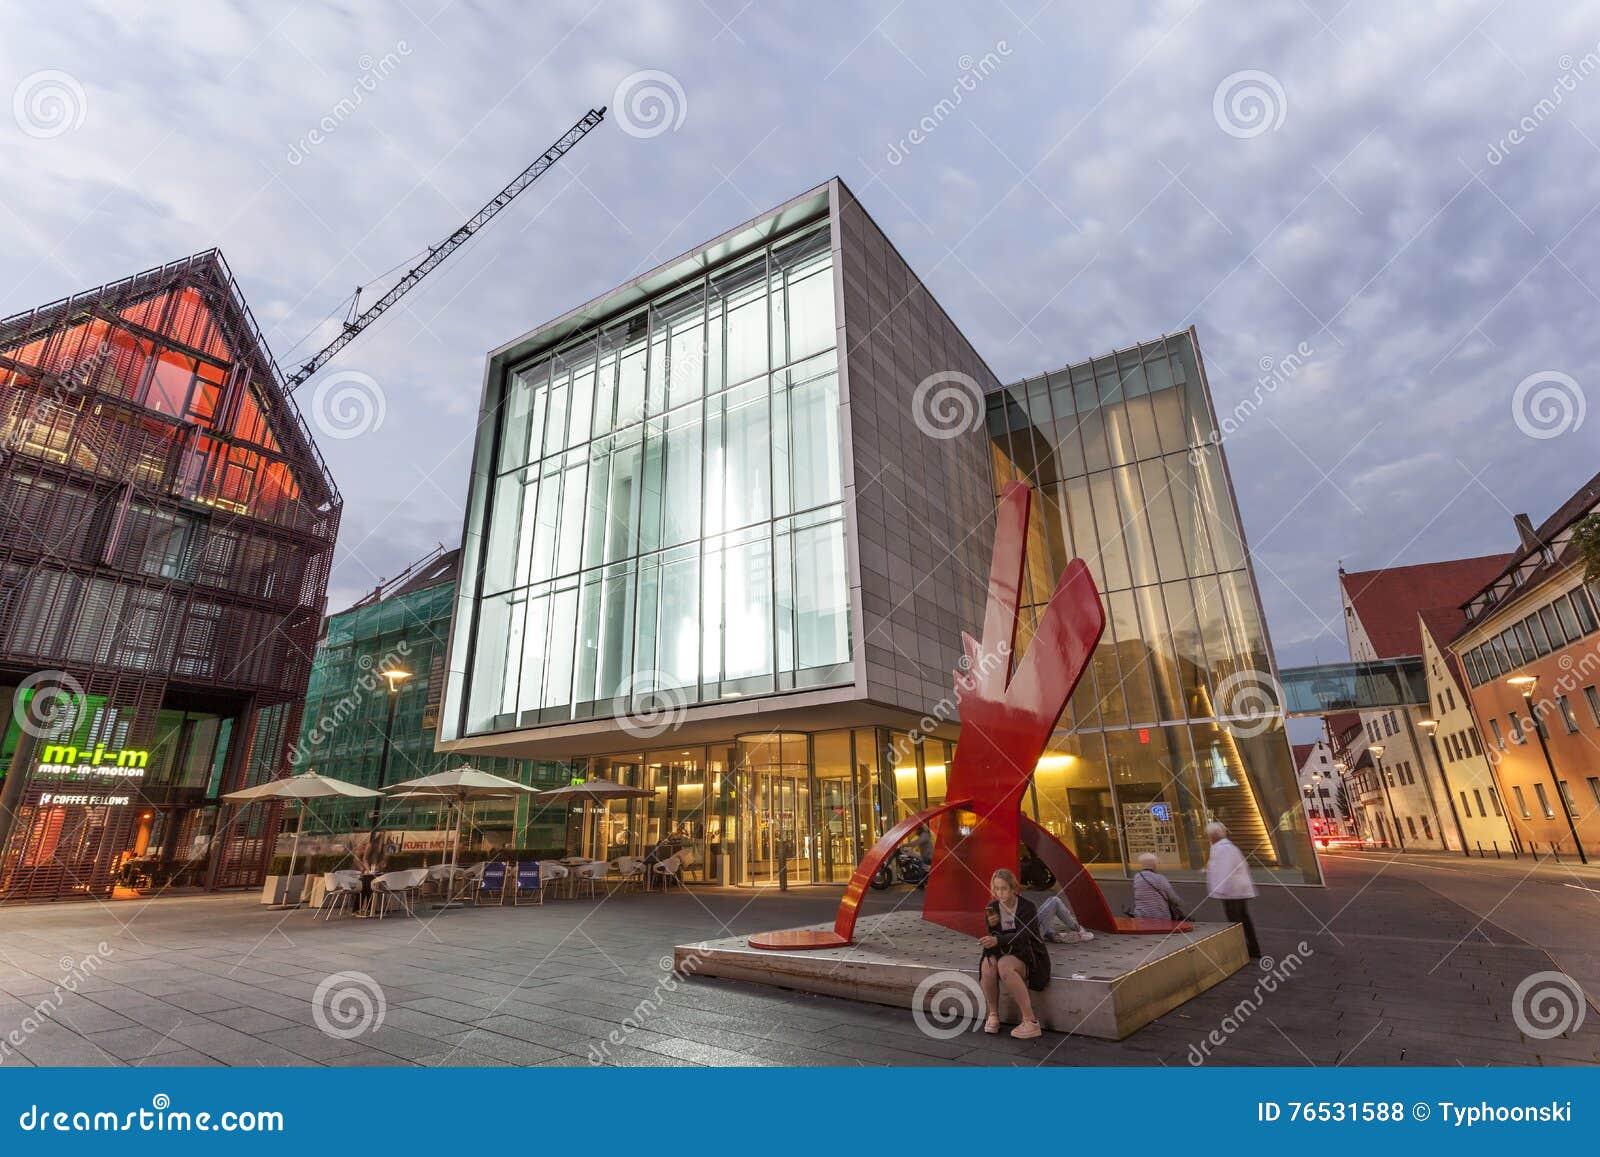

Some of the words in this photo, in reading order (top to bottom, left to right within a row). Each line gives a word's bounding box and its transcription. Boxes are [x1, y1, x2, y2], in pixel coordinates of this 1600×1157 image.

[42, 743, 149, 767] m-i-m
[38, 764, 145, 777] men-in-motion
[52, 795, 88, 804] COFFEE
[89, 796, 129, 805] FELLOWS
[403, 840, 428, 849] KURT
